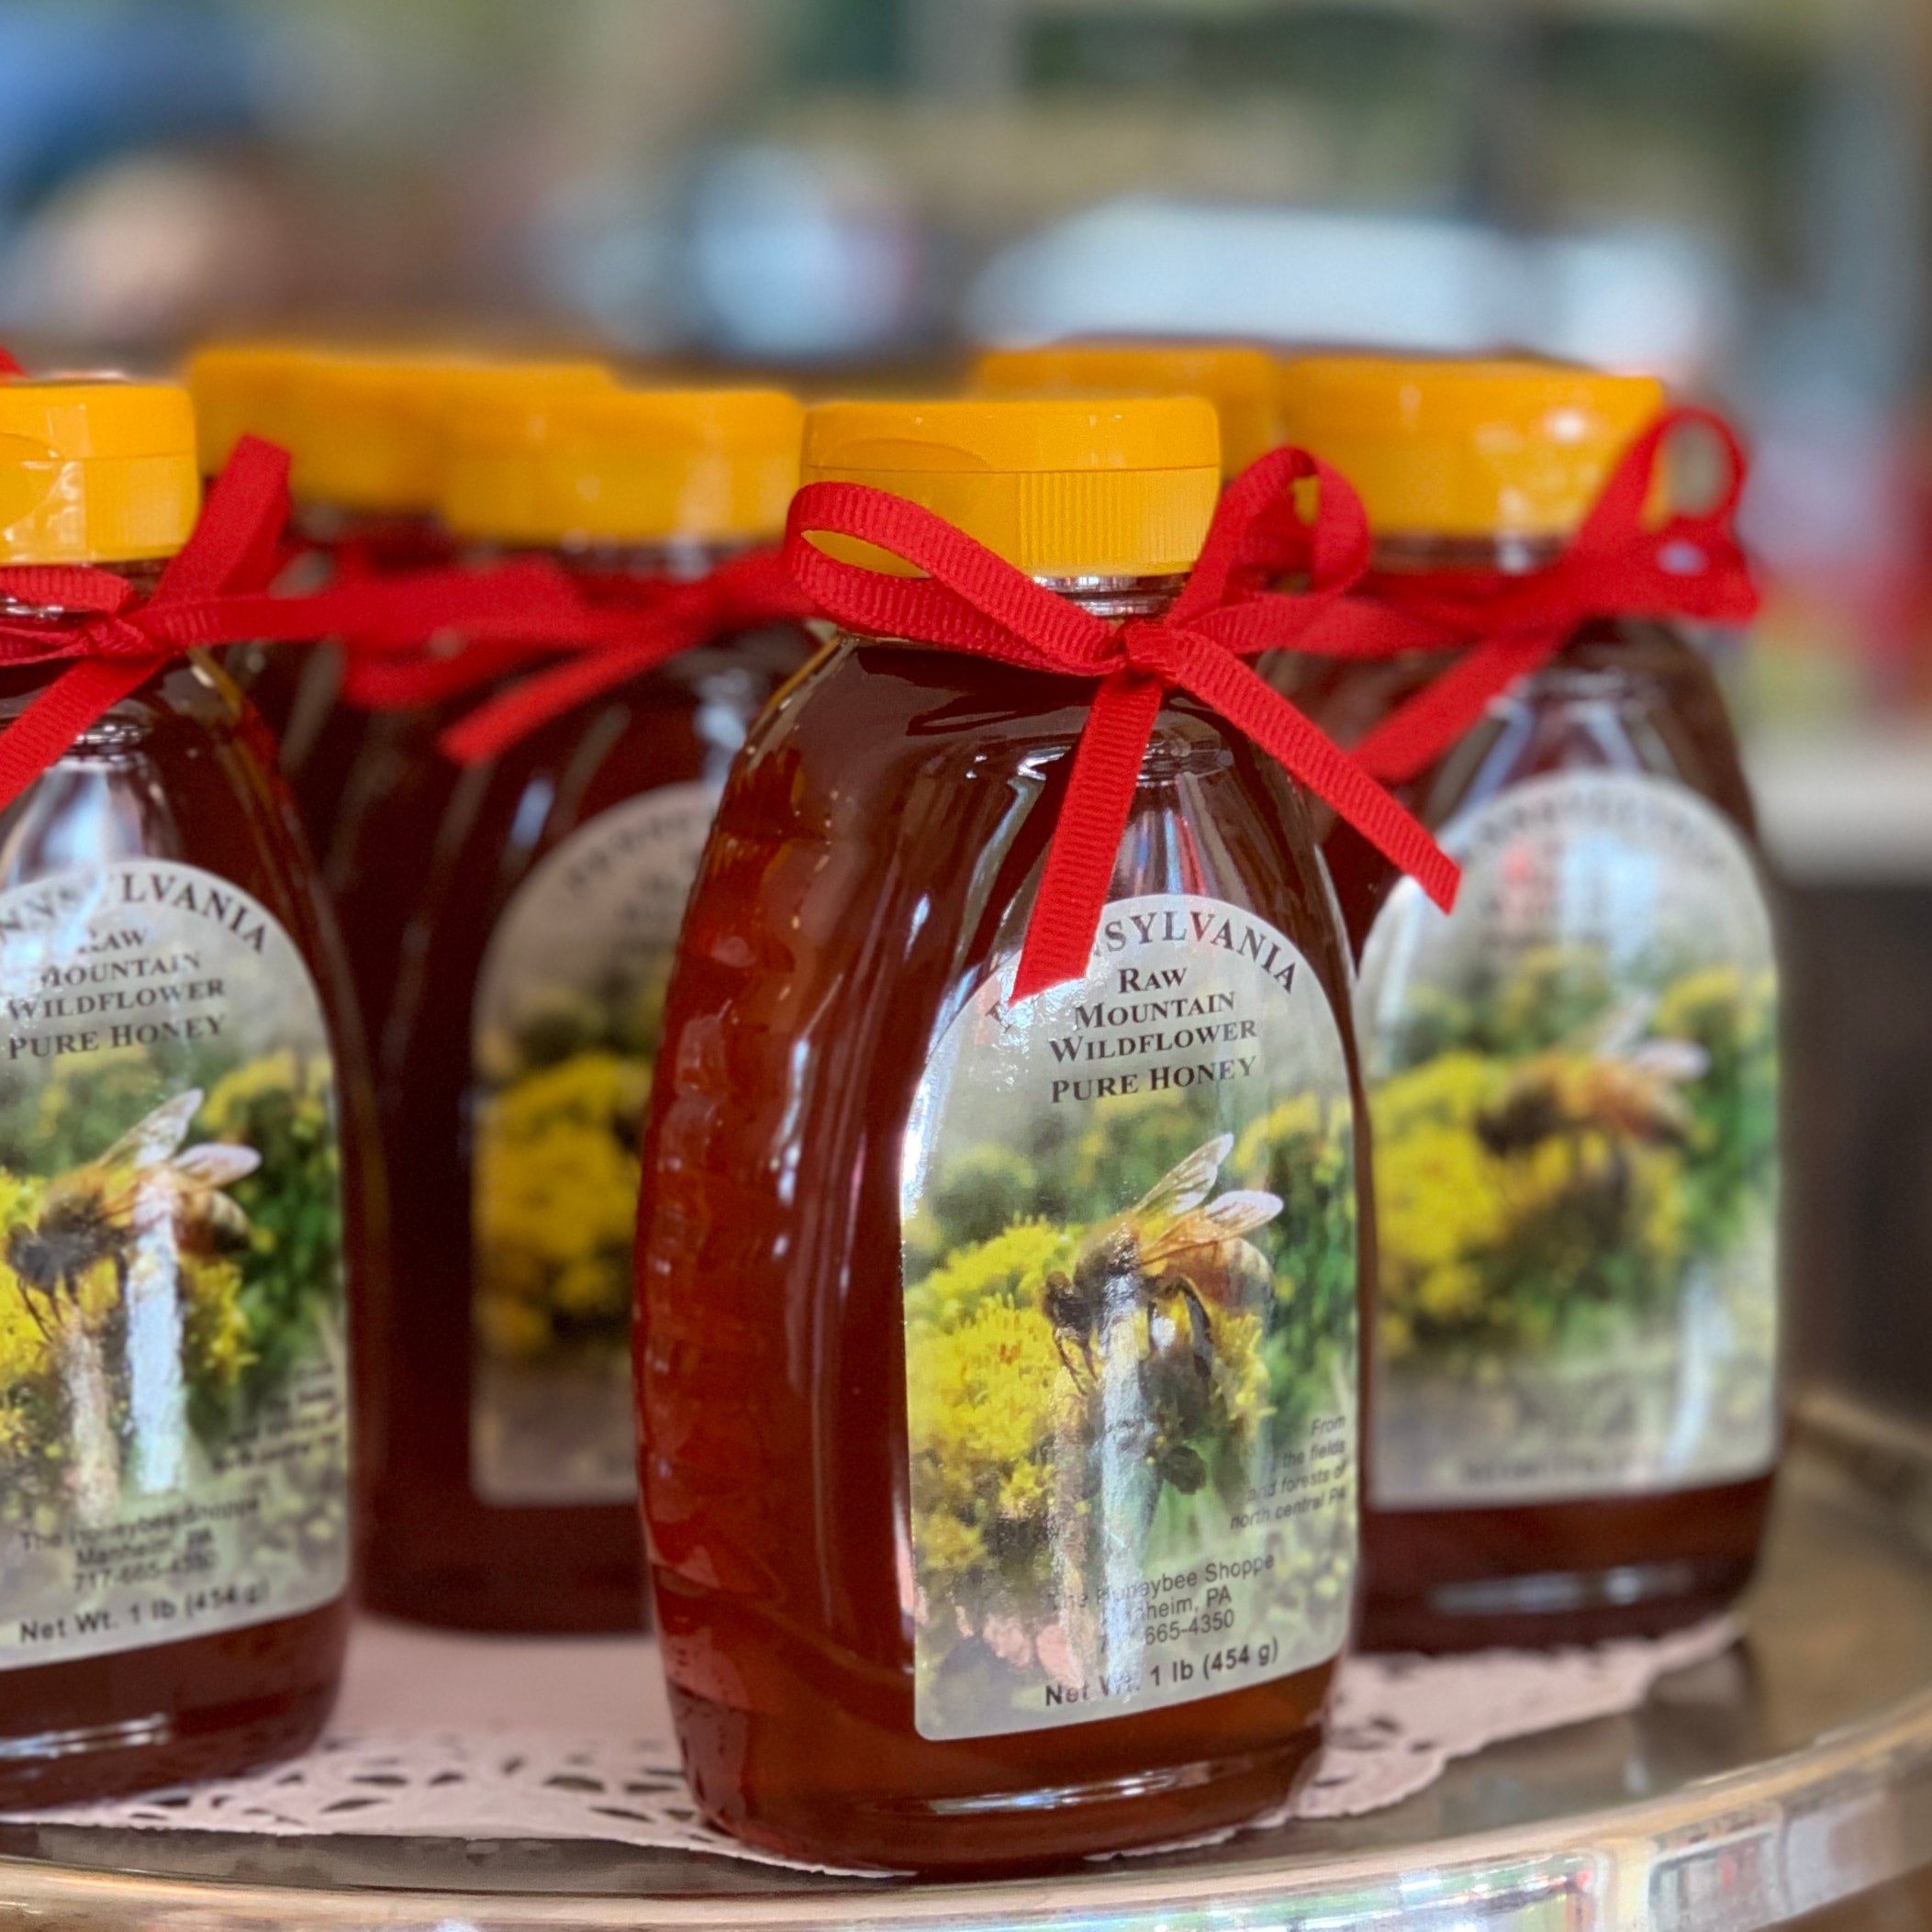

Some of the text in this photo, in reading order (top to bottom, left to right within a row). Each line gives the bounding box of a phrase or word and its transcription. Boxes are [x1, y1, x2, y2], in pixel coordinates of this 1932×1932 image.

[6, 978, 225, 1020] WILDFLOWER
[1117, 966, 1188, 994] RAW
[1074, 990, 1235, 1031] MOUNTAIN
[9, 1014, 225, 1060] PURE HONEY
[1049, 1019, 1257, 1064] WILDFLOWER
[1052, 1055, 1258, 1104] PURE HONEY
[1312, 1415, 1346, 1435] From
[1282, 1469, 1330, 1493] forests
[1230, 1508, 1269, 1530] north
[1275, 1491, 1324, 1519] central
[1204, 1555, 1275, 1583] Shoppe
[1206, 1585, 1232, 1608] PA
[20, 1618, 65, 1643] Net
[130, 1603, 140, 1624] 1
[152, 1600, 175, 1619] lb
[1045, 1683, 1090, 1707] Net
[1150, 1666, 1160, 1687] 1
[1173, 1660, 1193, 1682] lb
[1203, 1646, 1249, 1680] (454
[1258, 1637, 1279, 1667] g)
